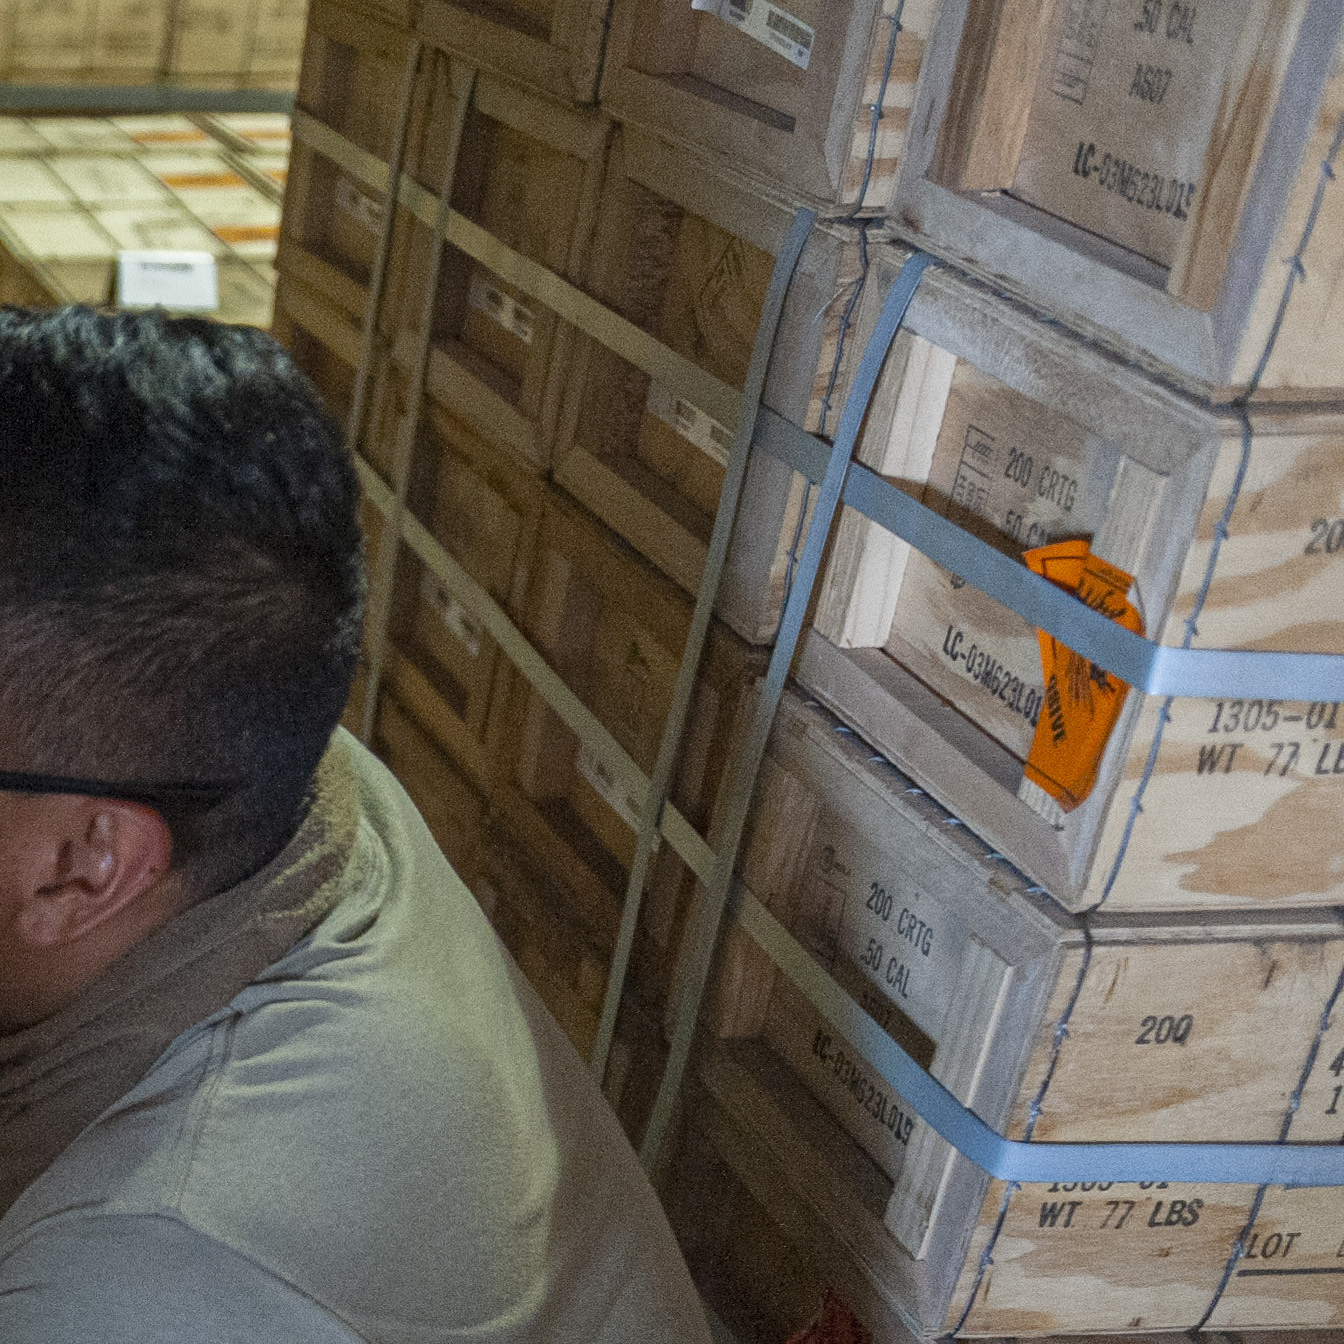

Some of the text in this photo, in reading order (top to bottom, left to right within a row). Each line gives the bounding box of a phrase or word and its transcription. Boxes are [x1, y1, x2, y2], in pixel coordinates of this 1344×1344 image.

[1004, 447, 1035, 489] 200
[942, 624, 1044, 728] LC-03M623L01
[1196, 740, 1245, 777] WT
[1263, 740, 1302, 778] 77
[865, 881, 935, 957] 200 CRTG
[885, 956, 912, 999] CAL
[1038, 1198, 1205, 1230] WT 77 LBS
[1243, 1231, 1303, 1260] LOT
